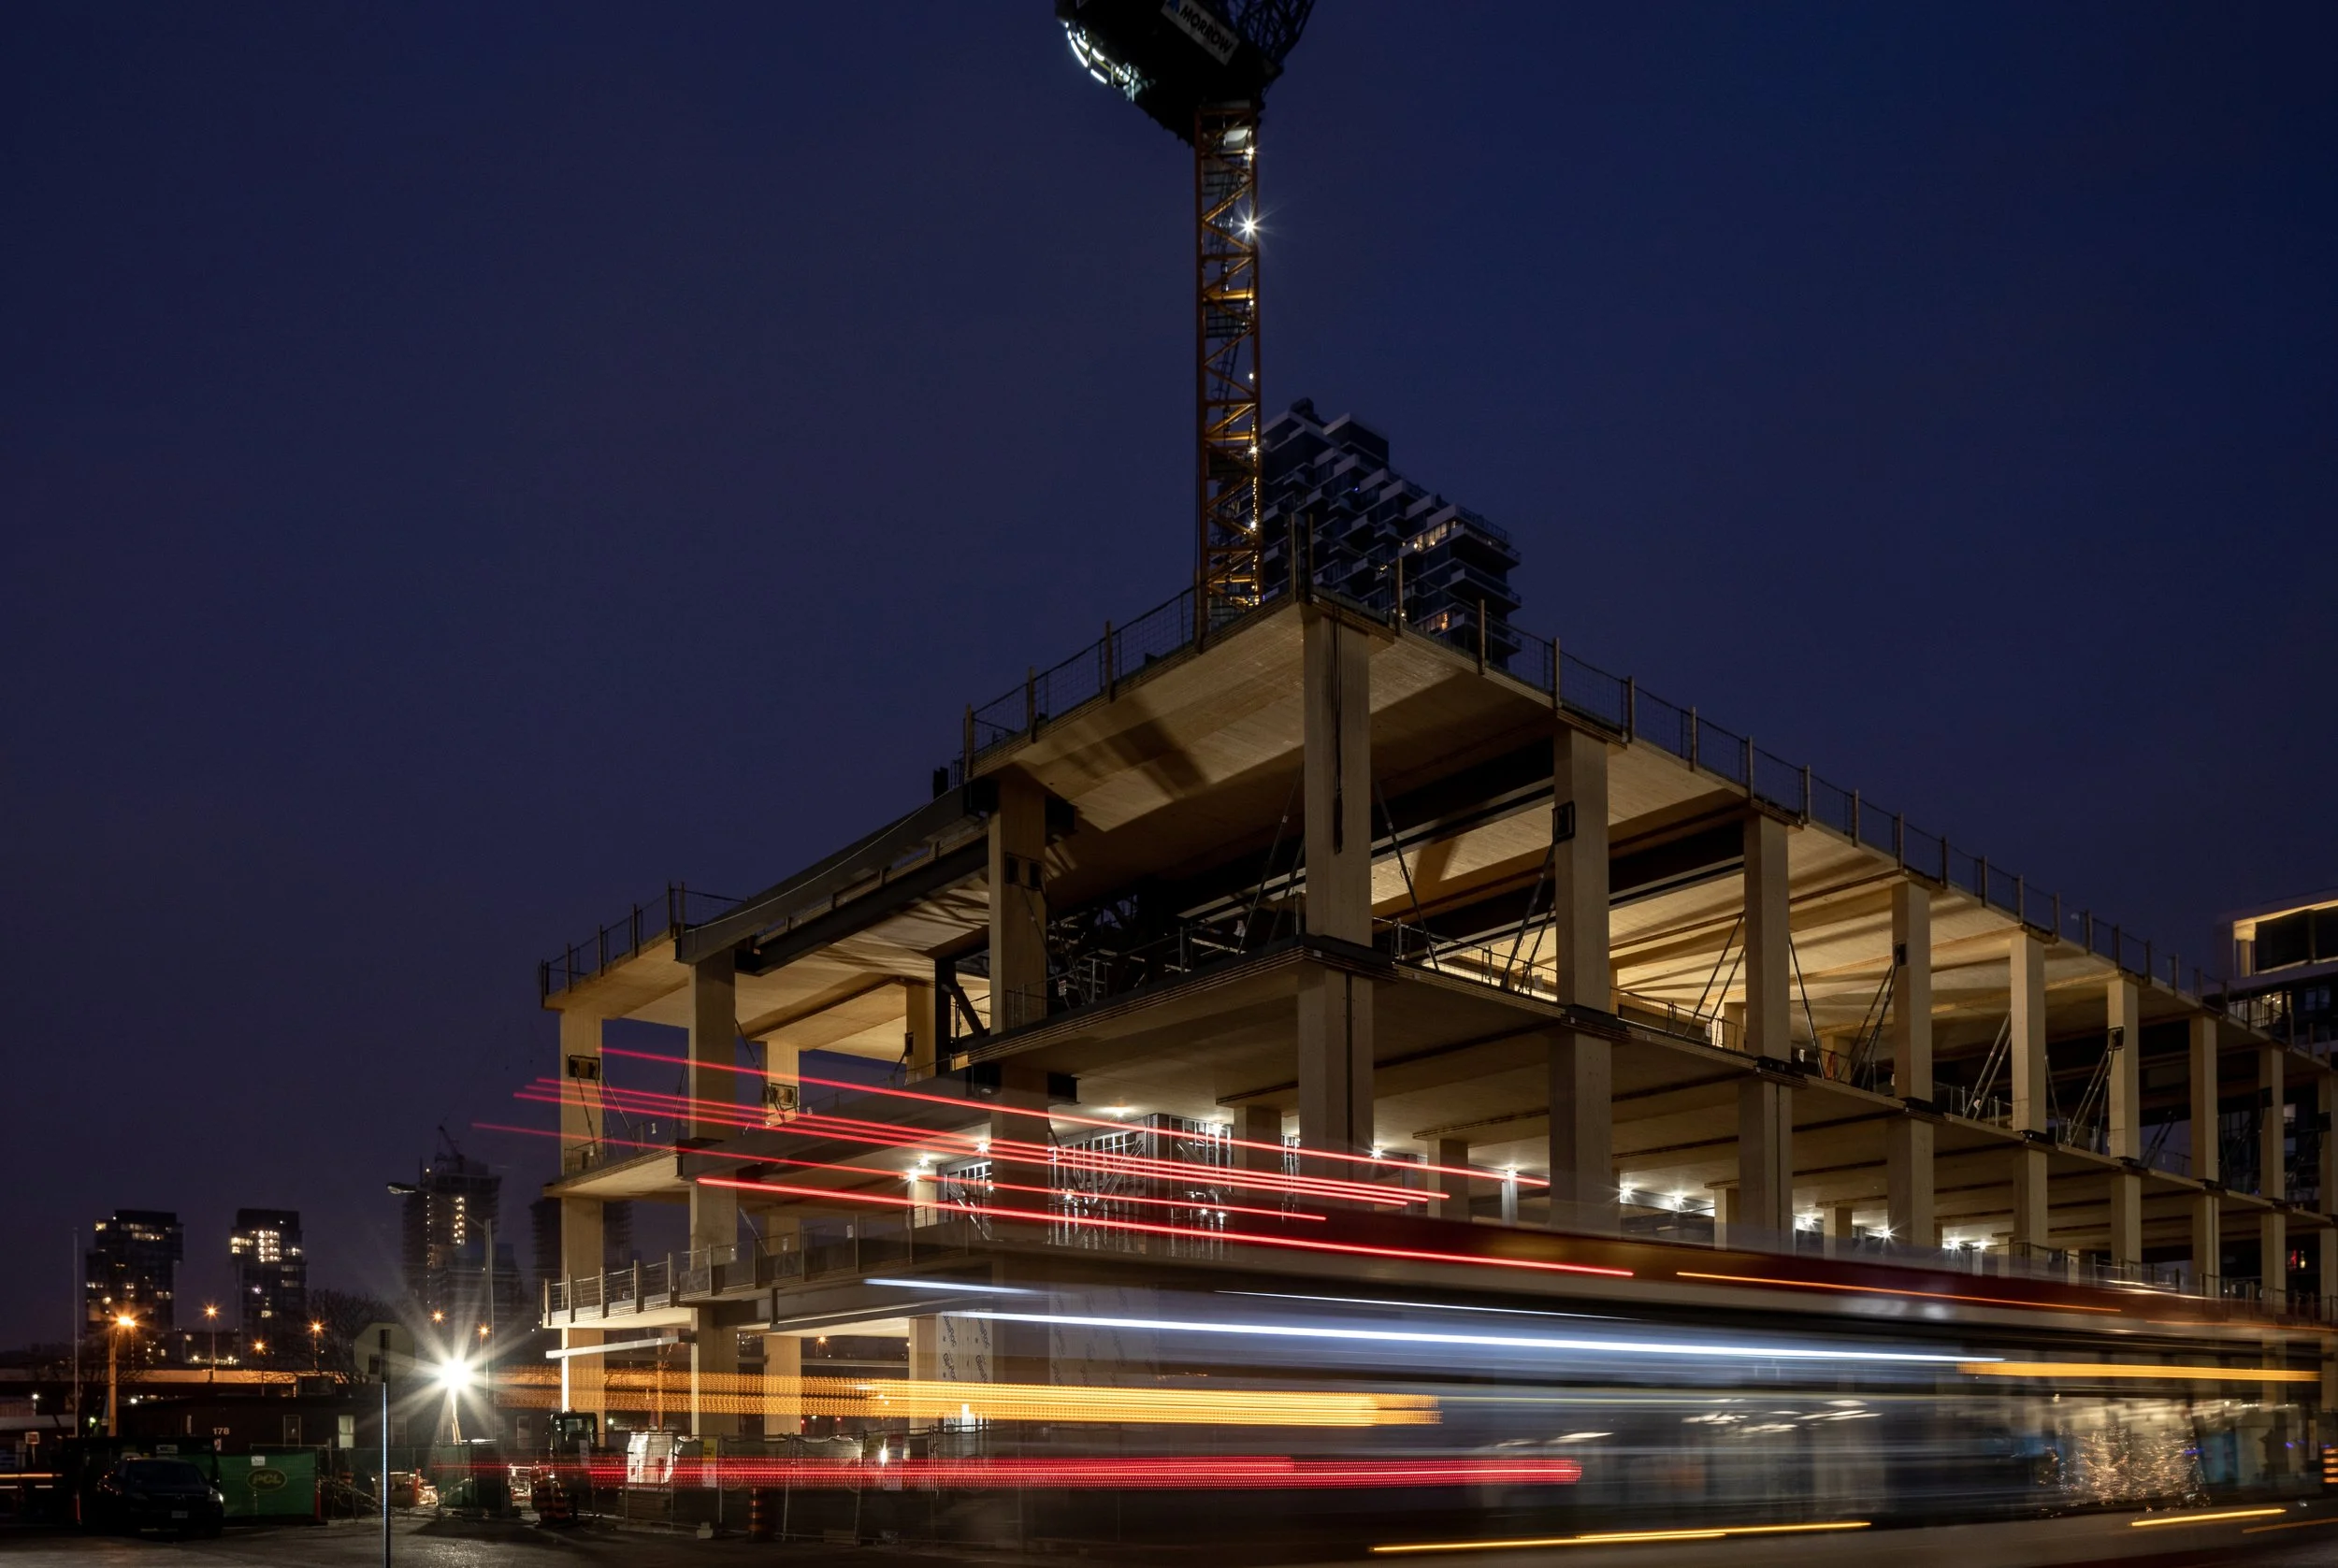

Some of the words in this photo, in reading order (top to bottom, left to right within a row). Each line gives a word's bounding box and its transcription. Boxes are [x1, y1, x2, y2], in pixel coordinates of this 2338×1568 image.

[1180, 6, 1233, 52] MORROW
[212, 1427, 230, 1435] 178
[253, 1473, 281, 1485] PCL
